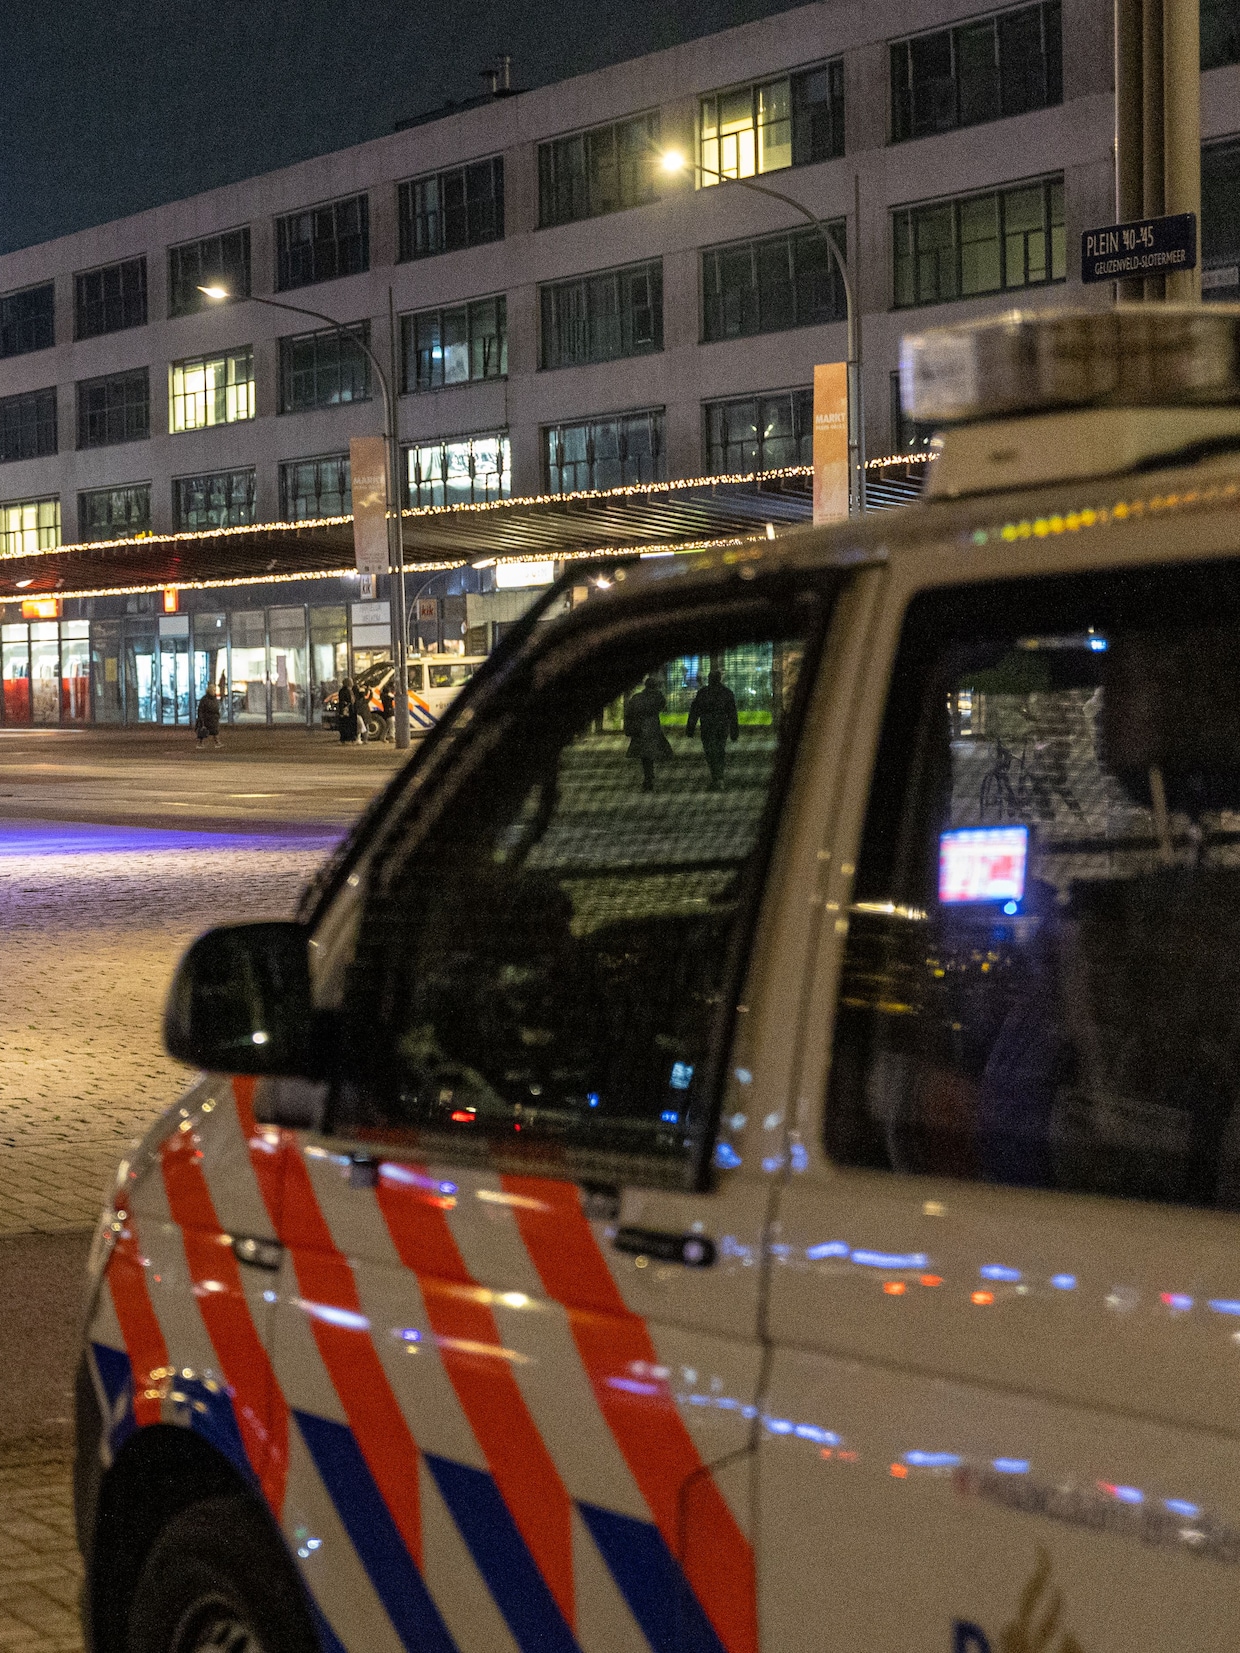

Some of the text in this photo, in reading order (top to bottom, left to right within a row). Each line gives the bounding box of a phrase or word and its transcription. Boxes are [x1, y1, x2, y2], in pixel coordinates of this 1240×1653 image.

[1086, 231, 1119, 257] PLEIN
[1094, 249, 1186, 275] GEUZENVELD-SLOTERMEER
[421, 603, 434, 615] kik
